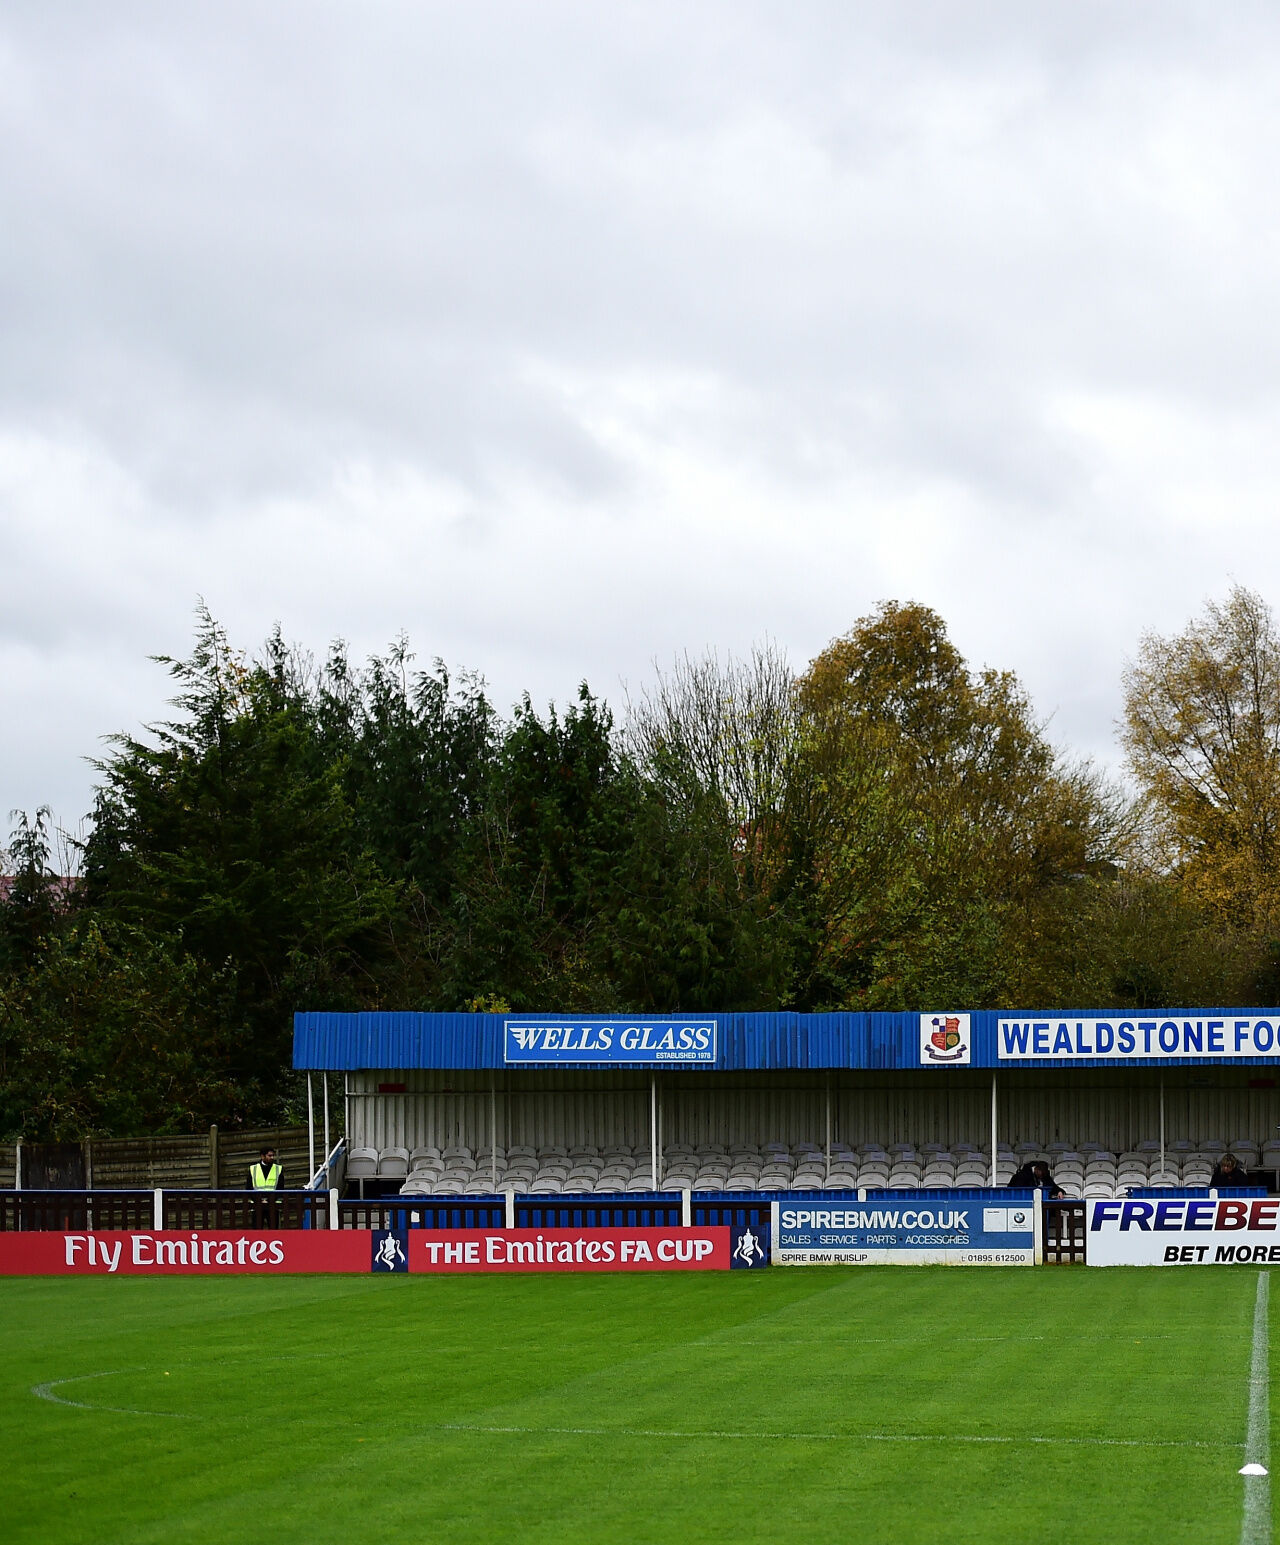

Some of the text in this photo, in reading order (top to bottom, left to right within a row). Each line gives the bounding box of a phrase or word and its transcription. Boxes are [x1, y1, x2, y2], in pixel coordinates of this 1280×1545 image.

[509, 1027, 711, 1050] WELLS GLASS
[1002, 1022, 1224, 1054] WEALDSTONE
[781, 1210, 970, 1229] SPIREBMW.CO.UK
[426, 1235, 714, 1264] THE Emirates FA CUP
[781, 1235, 970, 1245] SALES SERVICE PARTS ACCESSORIES
[64, 1233, 285, 1272] Fly Emirates
[781, 1254, 868, 1262] SPIRE BMW RUISLIP
[967, 1254, 993, 1262] 01895
[995, 1254, 1026, 1262] 612500
[1164, 1246, 1210, 1262] BET
